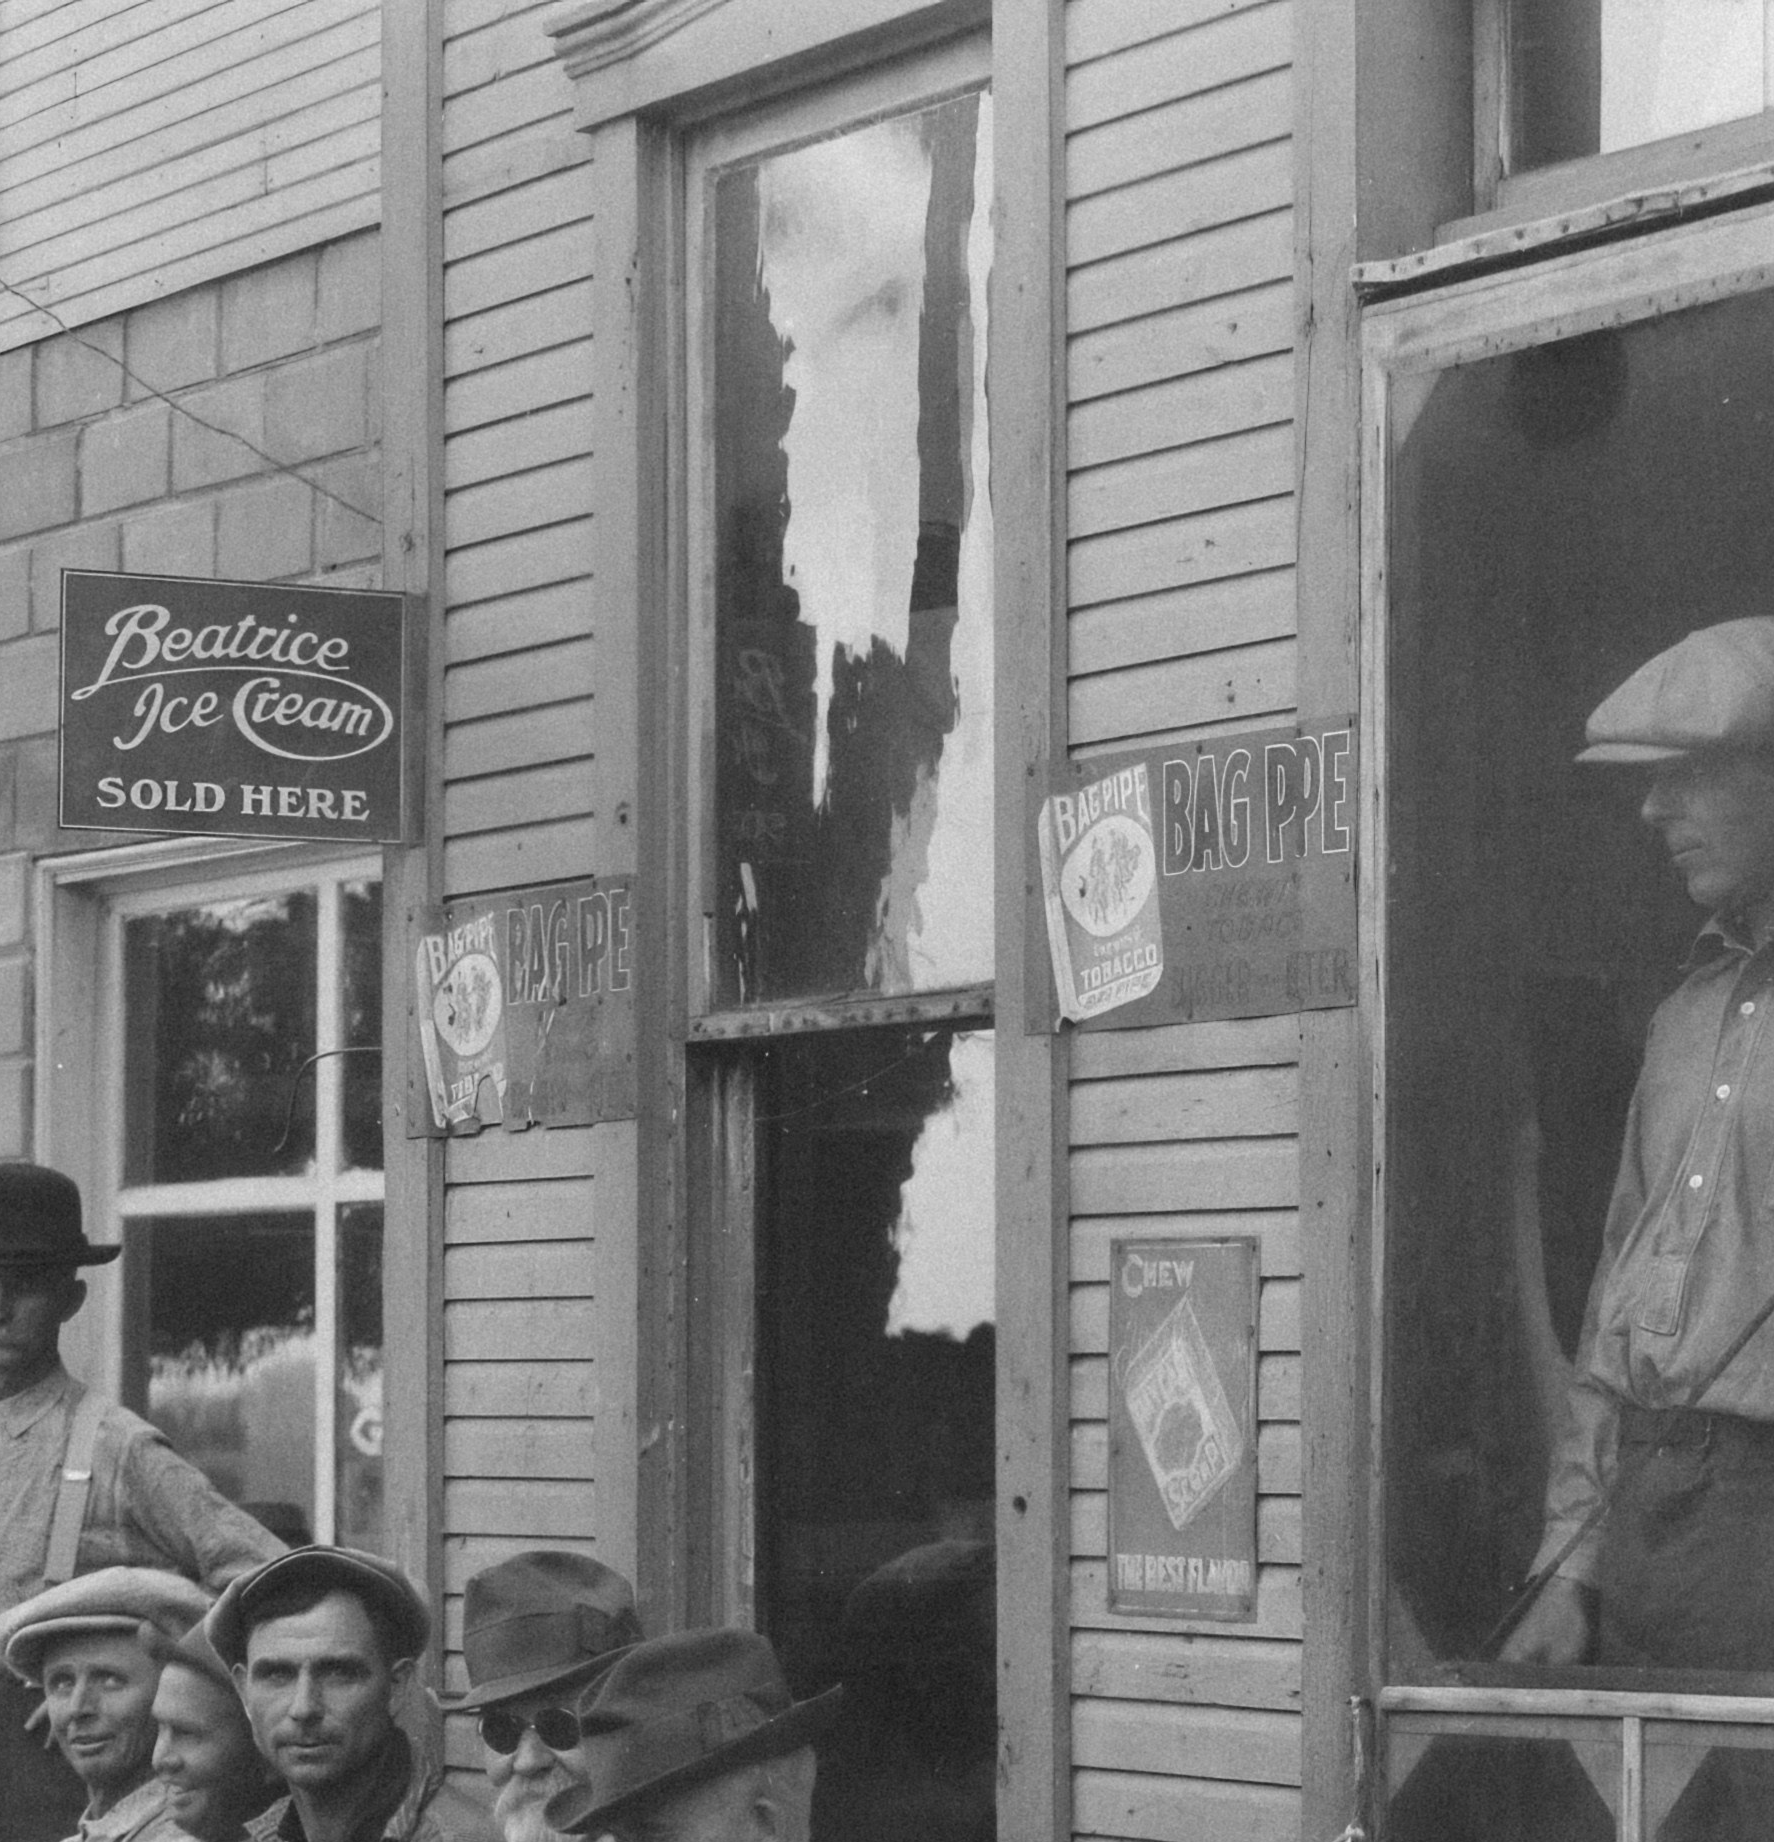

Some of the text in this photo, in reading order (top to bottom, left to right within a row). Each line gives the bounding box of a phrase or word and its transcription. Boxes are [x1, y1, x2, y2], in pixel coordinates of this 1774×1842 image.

[86, 604, 349, 692] Beatrice
[113, 677, 386, 752] Ice Cream
[97, 777, 370, 822] SOLD HERE
[1054, 783, 1101, 856] BAG
[1163, 749, 1251, 876] BAG
[507, 899, 570, 1006] BAG
[1080, 943, 1158, 991] TOBACCO
[1145, 1555, 1186, 1593] BEST
